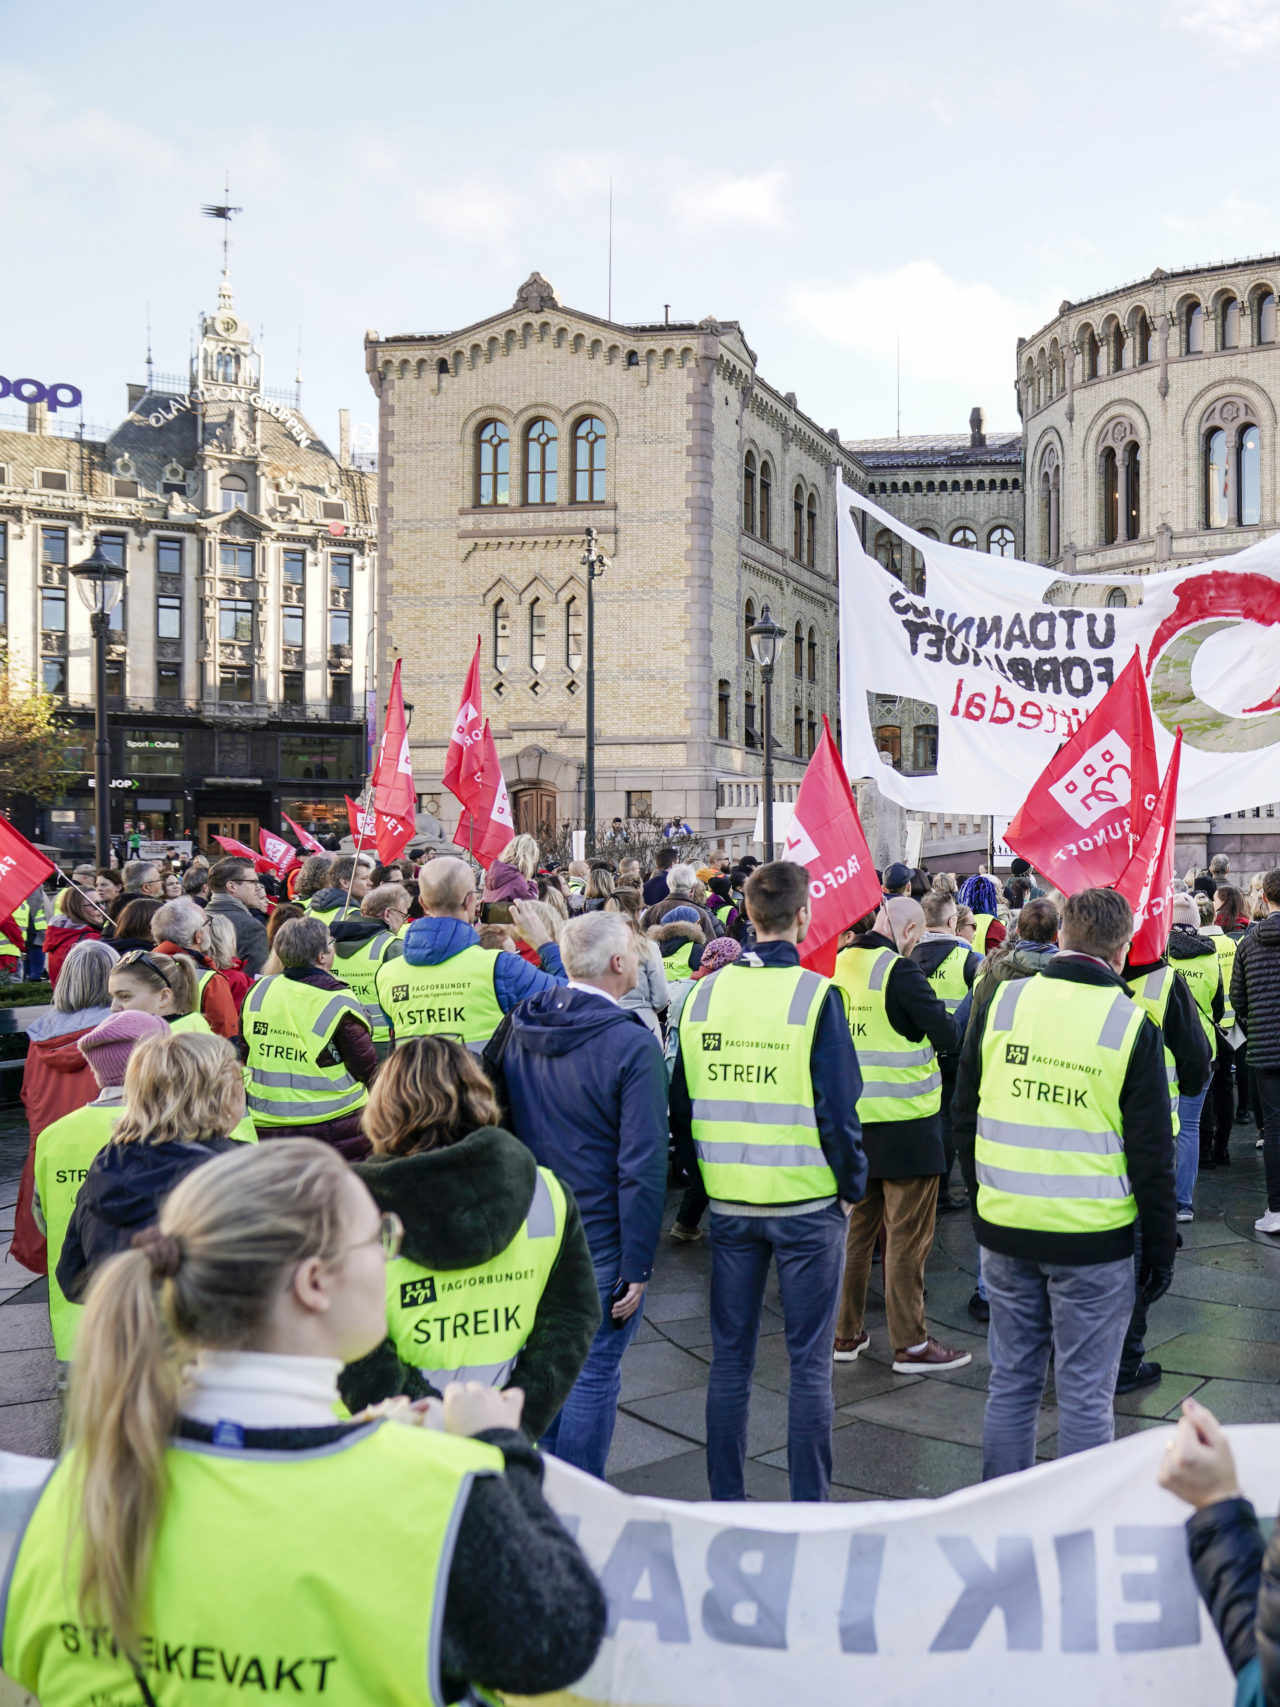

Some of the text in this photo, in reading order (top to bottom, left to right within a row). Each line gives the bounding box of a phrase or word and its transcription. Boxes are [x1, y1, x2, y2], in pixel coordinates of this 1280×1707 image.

[148, 394, 192, 428] OLAV
[249, 392, 311, 448] GRUPPEN
[126, 740, 180, 749] Sport Outlet
[412, 982, 471, 992] FAGFORBUNDET
[407, 1006, 466, 1025] STREIK
[258, 1043, 308, 1063] STREIK
[725, 1039, 790, 1051] FAGFORBUNDET
[707, 1063, 778, 1085] STREIK
[1032, 1055, 1102, 1077] FAGFORBUNDET
[1011, 1078, 1088, 1109] STREIK
[441, 1268, 535, 1293] FAGFORBUNDET
[413, 1304, 521, 1345] STREIK
[60, 1622, 337, 1693] STEIKEVAKT
